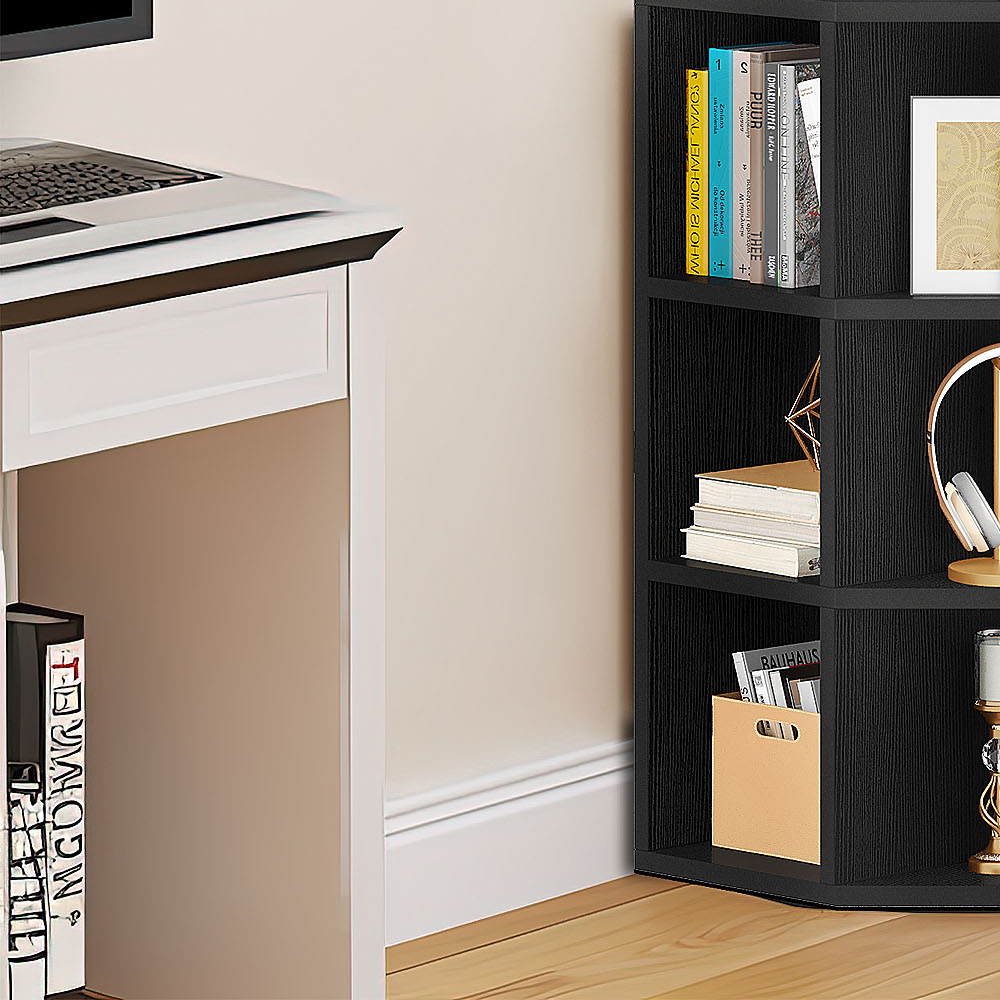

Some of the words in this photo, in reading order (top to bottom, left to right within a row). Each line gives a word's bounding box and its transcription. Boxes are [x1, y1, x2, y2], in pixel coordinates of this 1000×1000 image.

[715, 58, 722, 71] 1
[767, 72, 777, 102] EDWARD
[750, 91, 763, 130] PUUR
[751, 231, 763, 261] THEE
[760, 648, 820, 671] BAUHAUS
